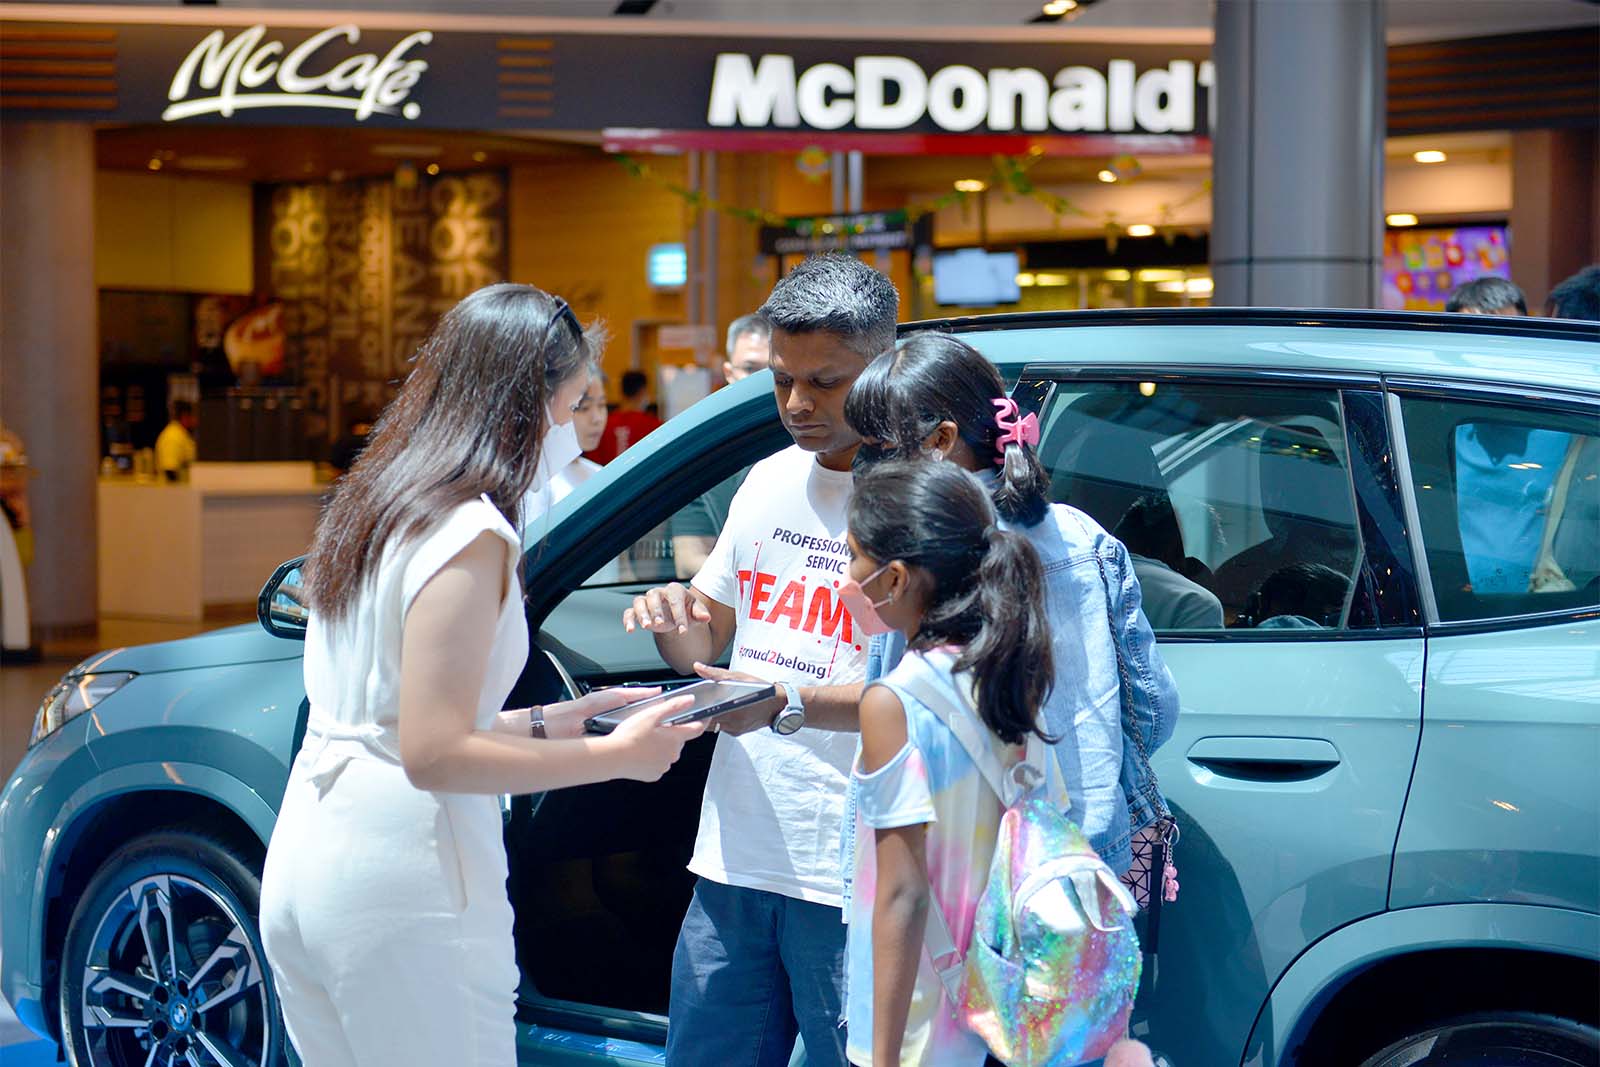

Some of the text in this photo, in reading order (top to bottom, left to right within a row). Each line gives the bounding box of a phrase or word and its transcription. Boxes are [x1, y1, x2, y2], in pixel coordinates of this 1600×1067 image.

[707, 53, 1217, 132] McDonald'
[805, 554, 847, 574] SERVIC
[738, 570, 852, 644] TEAM
